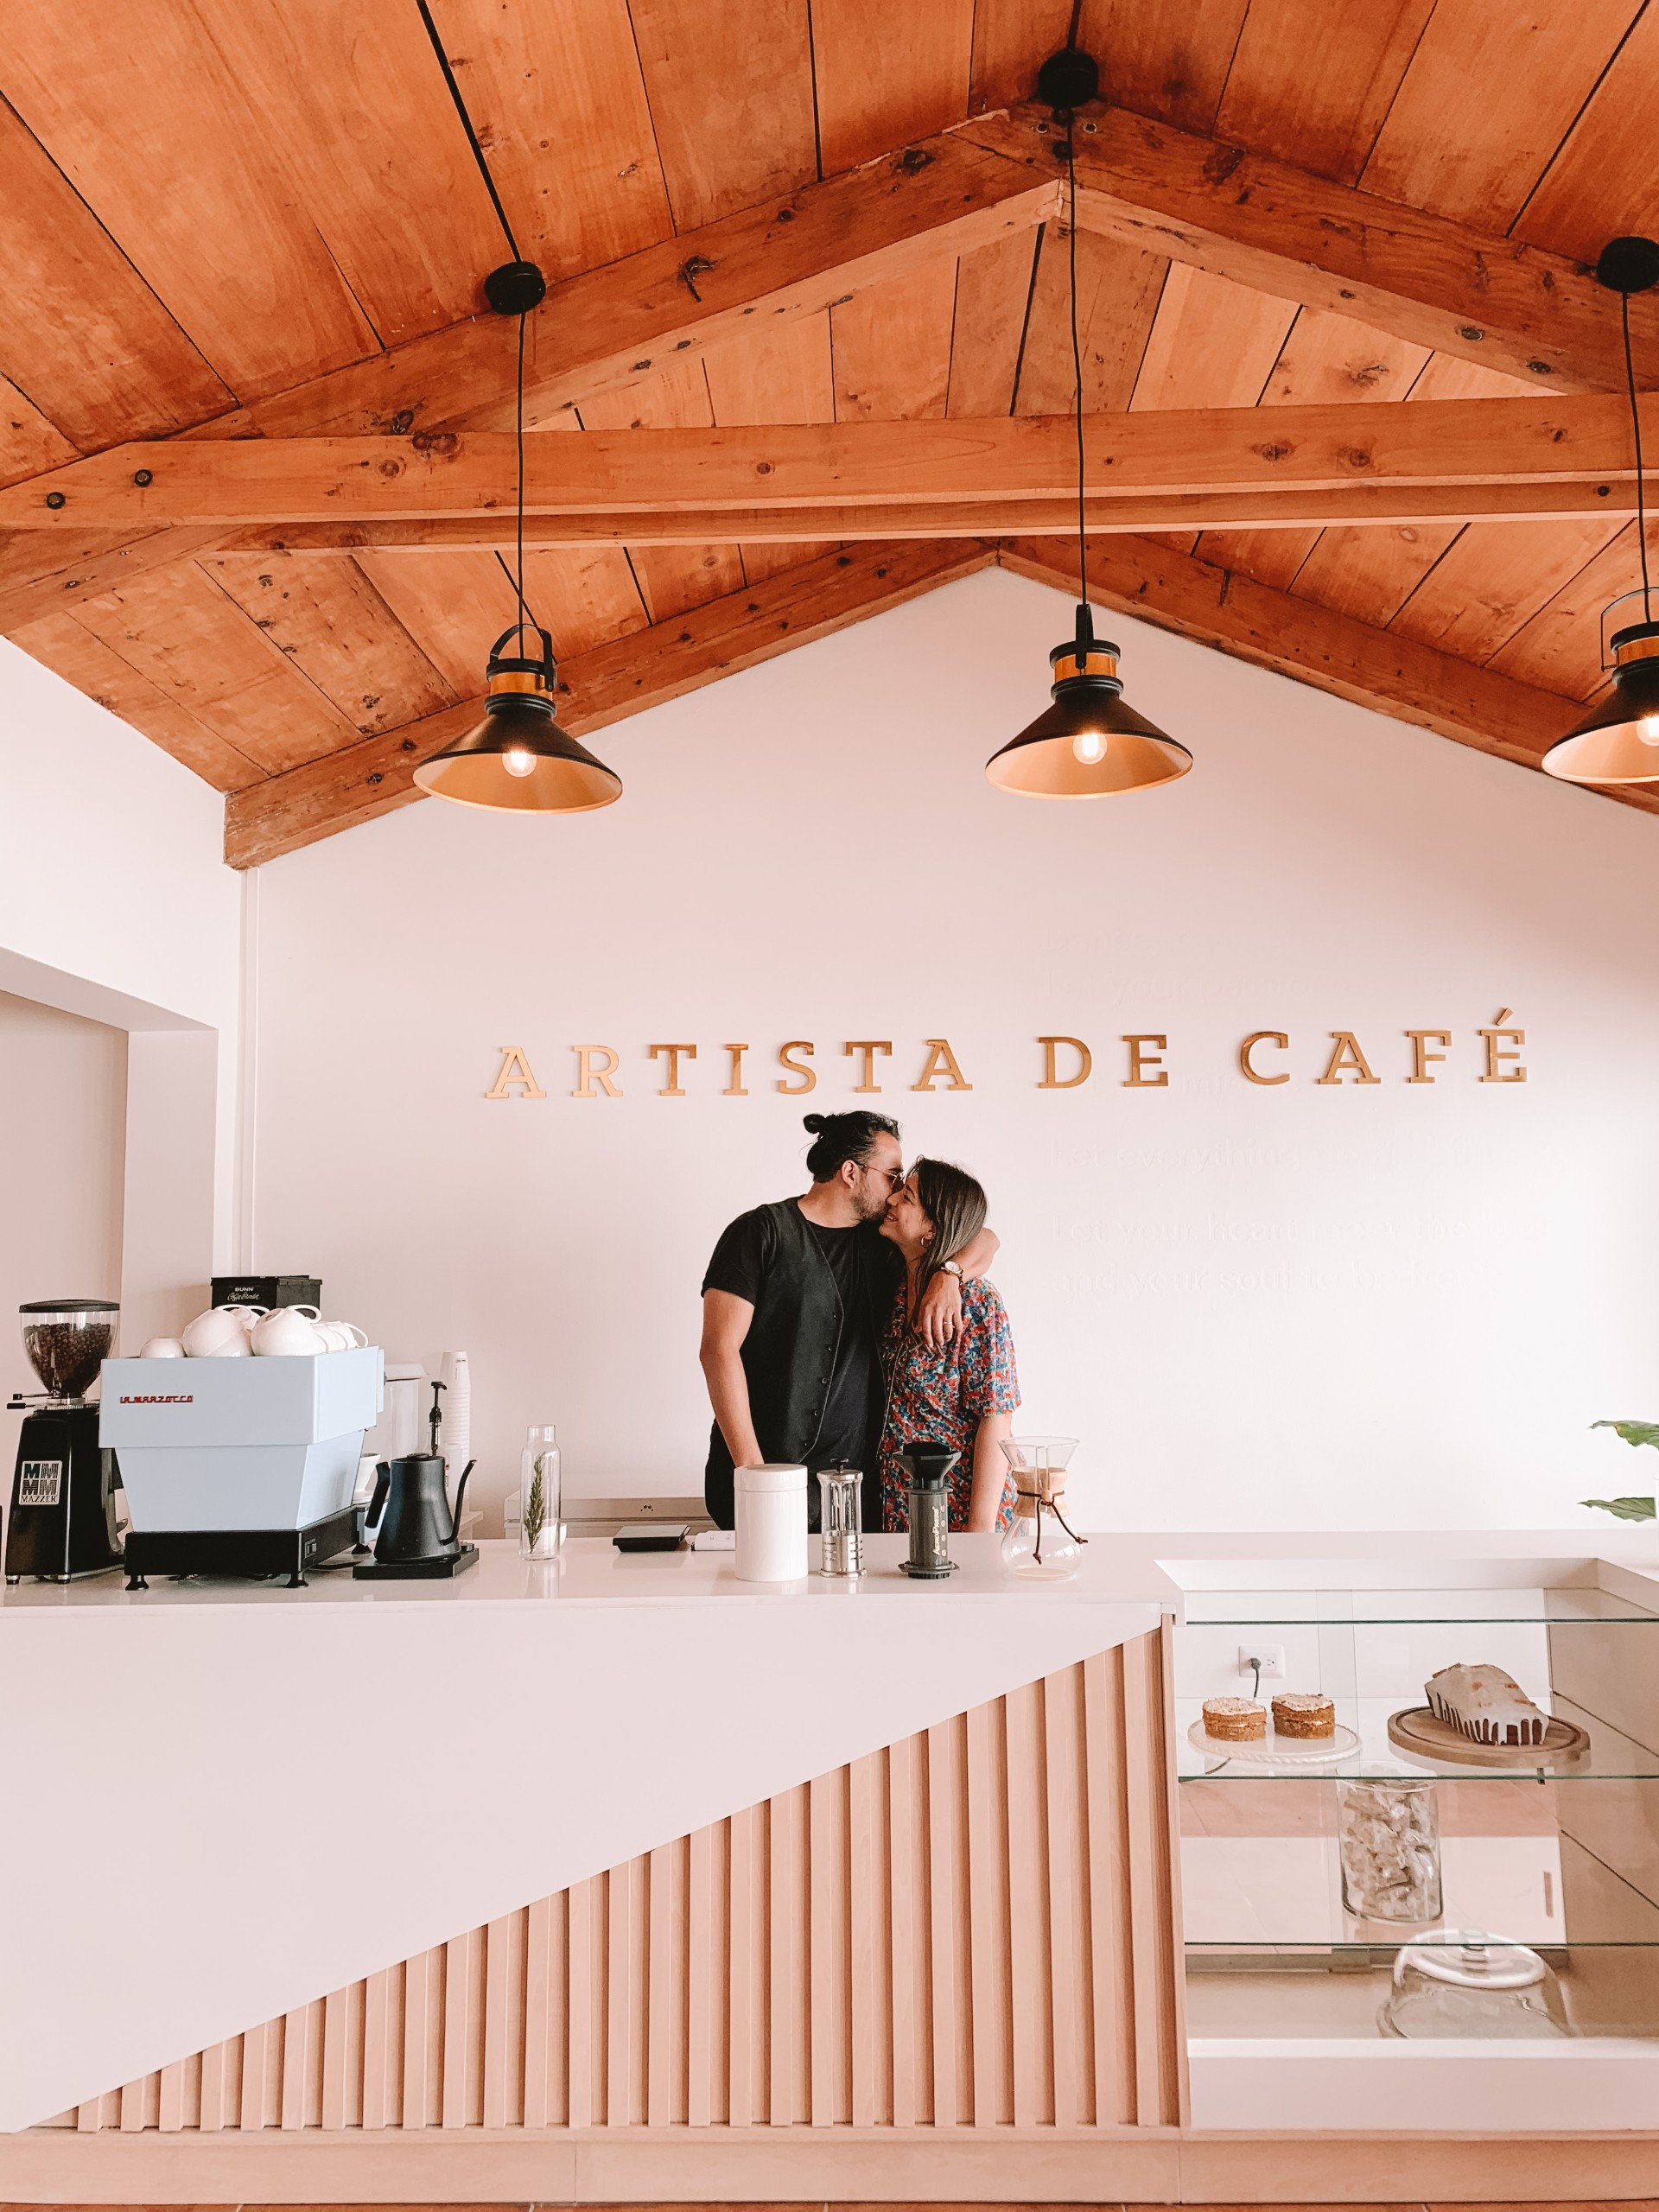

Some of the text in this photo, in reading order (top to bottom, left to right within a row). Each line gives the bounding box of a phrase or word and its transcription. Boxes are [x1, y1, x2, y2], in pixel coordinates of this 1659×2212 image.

[488, 1039, 972, 1098] ARTISTA
[1037, 1034, 1168, 1089] DE
[1237, 1008, 1526, 1085] CAFÉ
